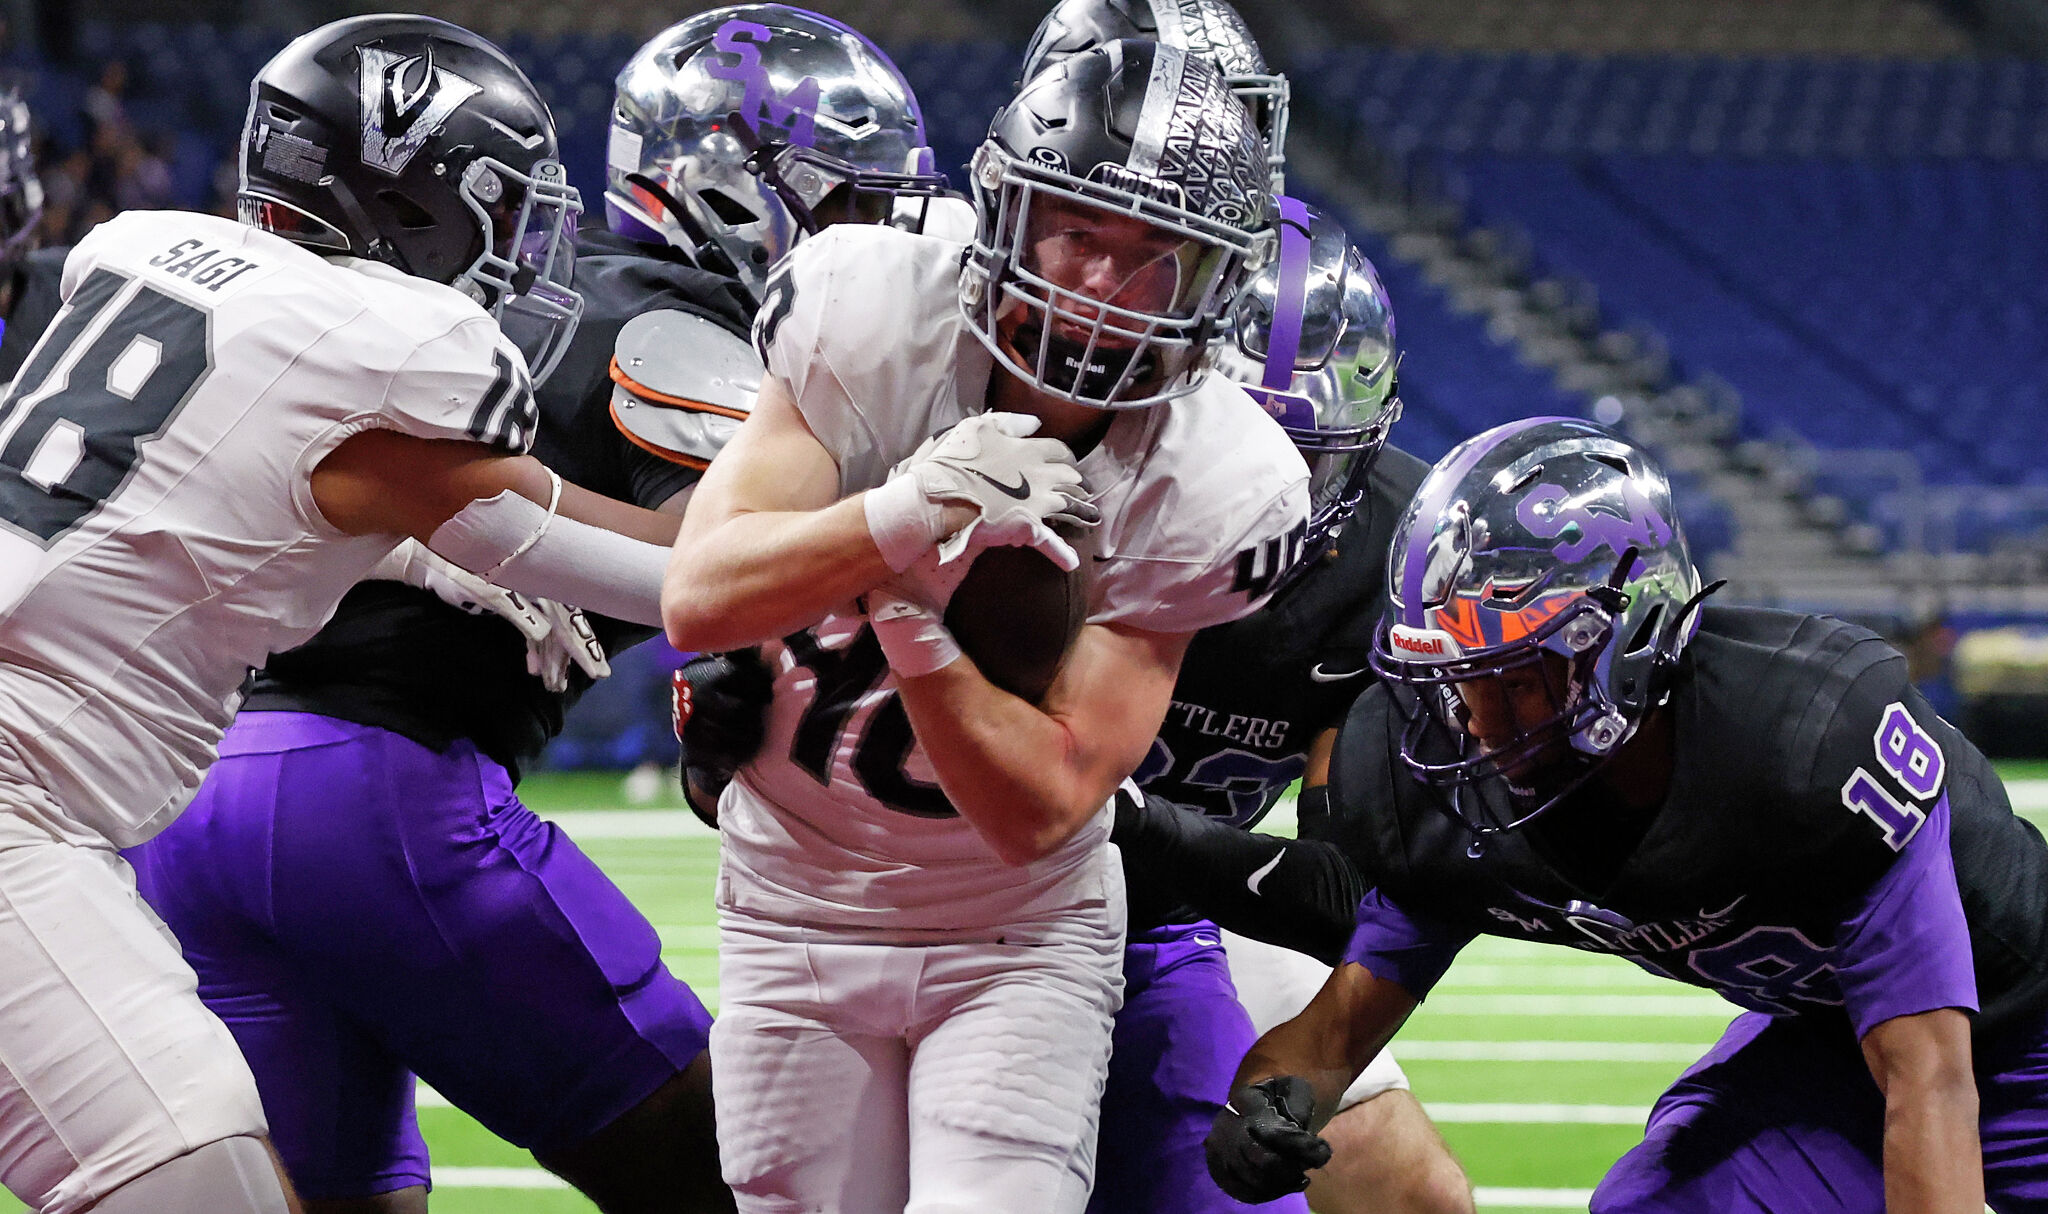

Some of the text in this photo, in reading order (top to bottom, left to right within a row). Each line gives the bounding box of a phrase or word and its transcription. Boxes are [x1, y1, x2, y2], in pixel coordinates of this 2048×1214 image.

[704, 19, 820, 148] SM
[149, 239, 260, 292] SAGI
[0, 265, 216, 552] 18
[464, 346, 538, 455] 18
[1515, 475, 1673, 583] SM
[1393, 632, 1443, 655] Riddell
[1171, 700, 1290, 749] TLERS
[1841, 701, 1946, 853] 18
